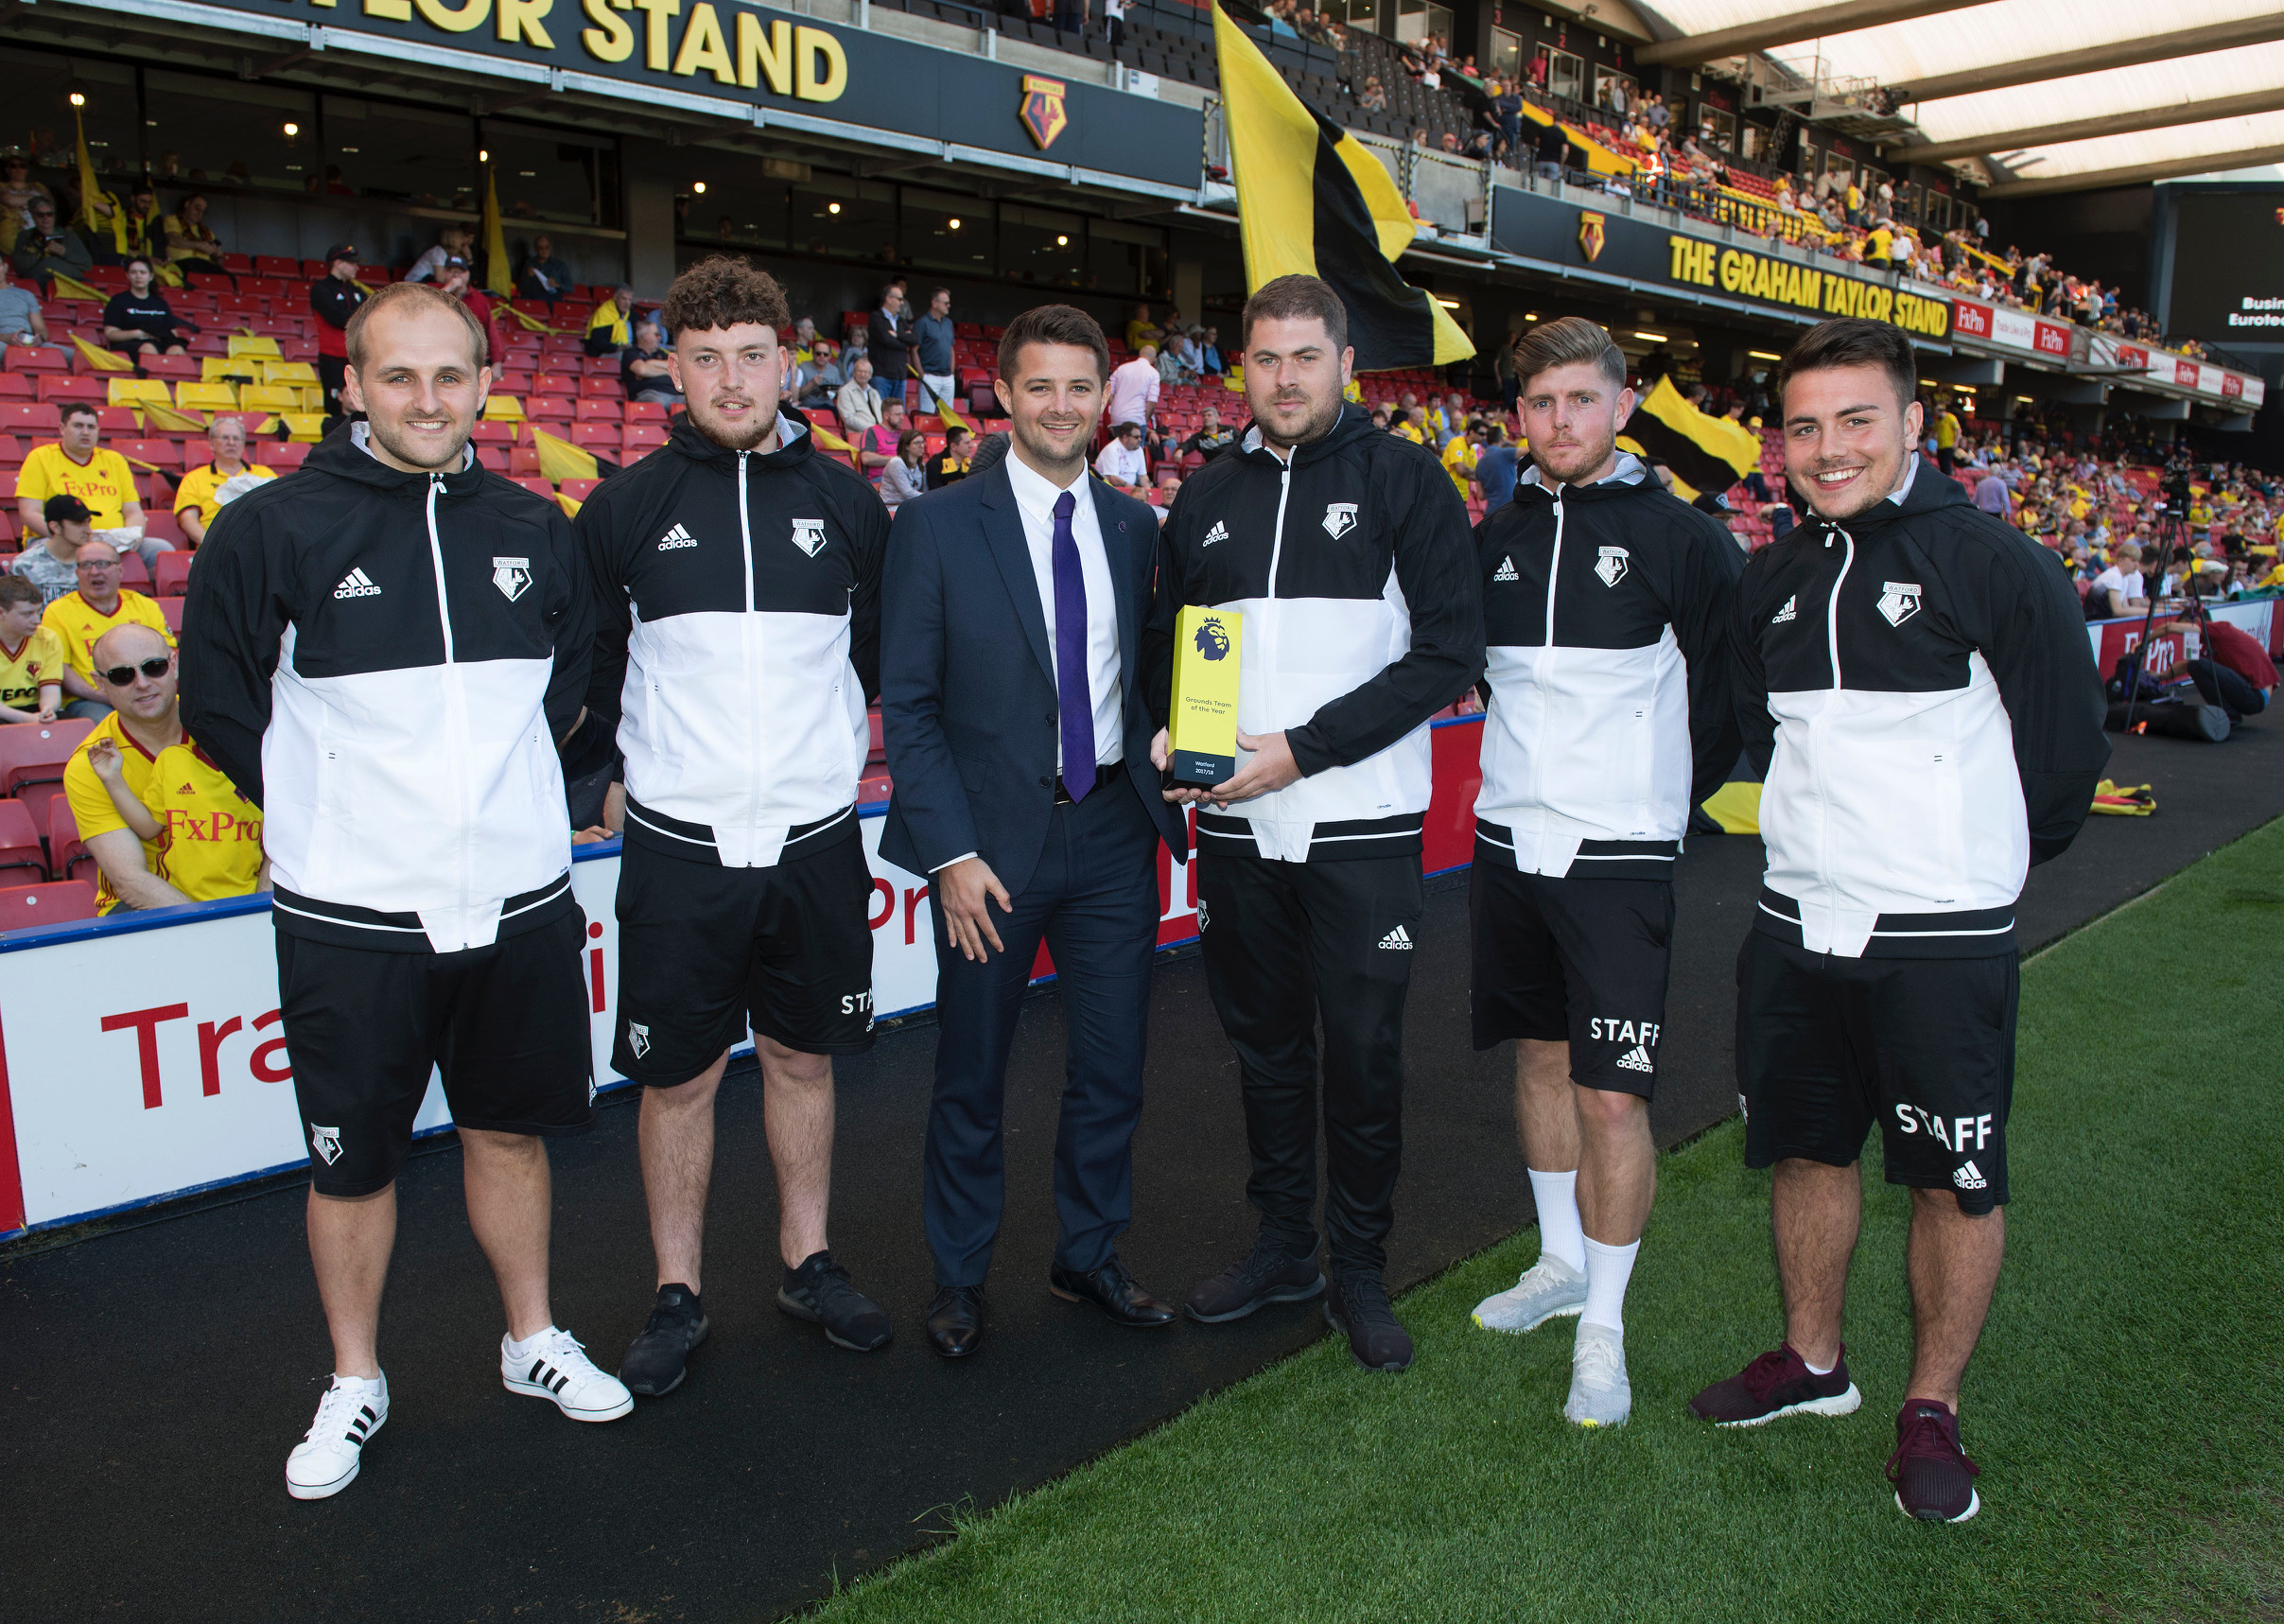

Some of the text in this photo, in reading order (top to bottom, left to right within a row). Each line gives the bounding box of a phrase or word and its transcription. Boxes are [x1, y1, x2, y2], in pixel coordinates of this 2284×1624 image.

[583, 0, 848, 103] STAND
[1669, 236, 1948, 338] THE GRAHAM TAYLOR STAND
[1958, 306, 1984, 333] FxPro
[2041, 327, 2064, 352] FxPro
[63, 481, 117, 497] FxPro
[657, 538, 698, 551] adidas
[1202, 532, 1229, 548] adidas
[1493, 571, 1519, 582] adidas
[333, 585, 382, 600] adidas
[1887, 585, 1918, 593] WATFORD
[1771, 611, 1797, 624] adidas
[1185, 696, 1232, 708] Grounds Team
[166, 809, 262, 842] FxPro
[1378, 939, 1414, 951] adidas
[841, 987, 873, 1015] STA
[1590, 1017, 1661, 1047] STAFF
[100, 1002, 293, 1110] Tra
[1616, 1058, 1653, 1074] adidas
[1895, 1103, 1992, 1152] STAFF
